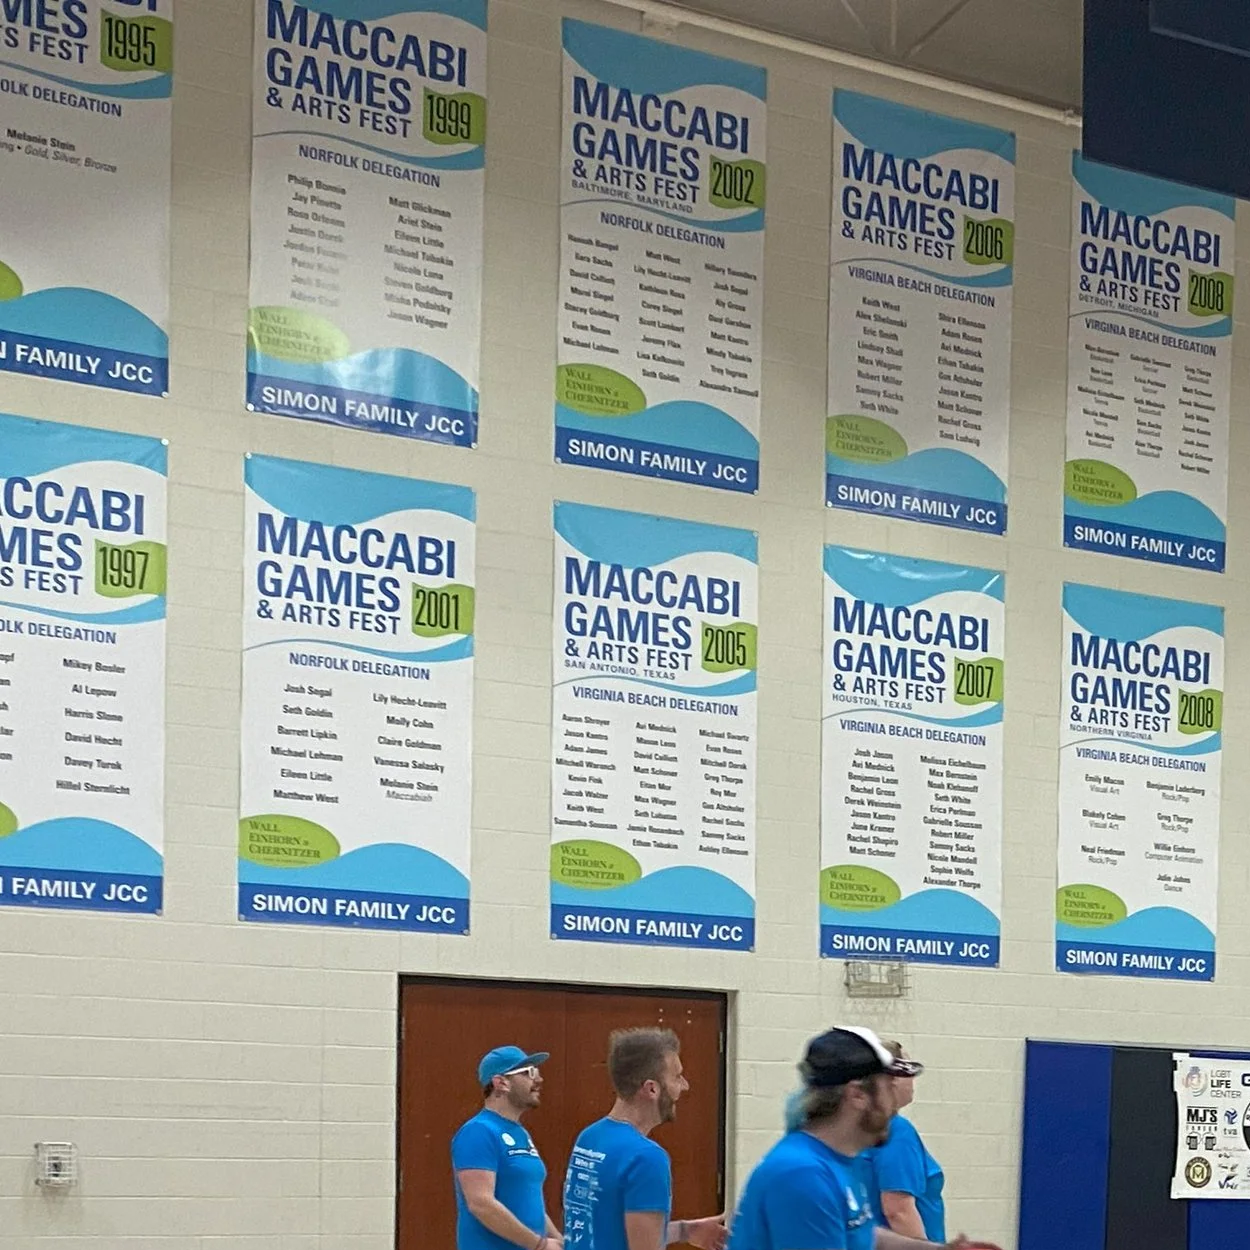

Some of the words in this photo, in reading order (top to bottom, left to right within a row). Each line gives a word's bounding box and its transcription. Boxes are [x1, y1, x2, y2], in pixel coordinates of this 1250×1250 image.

[105, 18, 155, 66] 1995
[267, 0, 467, 87] MACCABI
[267, 47, 411, 115] GAMES
[267, 88, 283, 109] &
[292, 94, 350, 124] ARTS
[360, 109, 411, 138] FEST
[427, 94, 470, 139] 1999
[573, 76, 748, 154] MACCABI
[299, 145, 358, 169] NORFOLK
[362, 159, 440, 188] DELEGATION
[573, 122, 700, 182] GAMES
[573, 159, 587, 179] &
[595, 165, 646, 192] ARTS
[654, 178, 700, 204] FEST
[713, 162, 754, 204] 2002
[843, 143, 998, 213] MACCABI
[637, 195, 693, 213] MARYLAND
[842, 186, 955, 240] GAMES
[601, 212, 653, 234] NORFOLK
[656, 224, 725, 248] DELEGATION
[842, 221, 855, 239] &
[862, 225, 907, 251] ARTS
[915, 237, 955, 261] FEST
[966, 221, 1003, 260] 2006
[1081, 202, 1220, 267] MACCABI
[848, 265, 894, 287] VIRGINIA
[897, 277, 931, 294] BEACH
[935, 285, 995, 307] DELEGATION
[1080, 242, 1181, 293] GAMES
[1080, 275, 1091, 292] &
[1097, 279, 1138, 303] ARTS
[1144, 290, 1180, 312] FEST
[1191, 274, 1223, 311] 2008
[16, 344, 101, 374] FAMILY
[109, 361, 153, 383] JCC
[262, 387, 337, 414] SIMON
[345, 400, 419, 428] FAMILY
[425, 415, 464, 436] JCC
[569, 439, 634, 464] SIMON
[641, 450, 707, 476] FAMILY
[713, 464, 747, 483] JCC
[838, 485, 896, 509] SIMON
[902, 496, 961, 519] FAMILY
[966, 506, 996, 526] JCC
[258, 512, 455, 578] MACCABI
[25, 570, 83, 595] FEST
[99, 546, 149, 590] 1997
[257, 560, 400, 612] GAMES
[565, 557, 740, 617] MACCABI
[257, 600, 273, 619] &
[282, 603, 340, 627] ARTS
[350, 613, 400, 635] FEST
[415, 590, 459, 630] 2001
[565, 602, 691, 650] GAMES
[834, 596, 989, 652] MACCABI
[28, 623, 117, 644] DELEGATION
[705, 628, 746, 665] 2005
[289, 652, 349, 671] NORFOLK
[353, 661, 430, 680] DELEGATION
[564, 660, 585, 669] SAN
[644, 670, 675, 680] TEXAS
[565, 639, 579, 657] &
[587, 642, 639, 664] ARTS
[647, 649, 692, 671] FEST
[833, 639, 946, 683] GAMES
[1072, 632, 1210, 684] MACCABI
[833, 674, 846, 691] &
[853, 676, 898, 698] ARTS
[906, 683, 946, 703] FEST
[957, 663, 993, 698] 2007
[1071, 672, 1171, 714] GAMES
[573, 686, 625, 702] VIRGINIA
[628, 693, 666, 707] BEACH
[670, 698, 738, 716] DELEGATION
[884, 700, 912, 710] TEXAS
[1181, 694, 1213, 728] 2008
[840, 719, 886, 734] VIRGINIA
[889, 725, 923, 739] BEACH
[926, 729, 986, 746] DELEGATION
[1070, 723, 1114, 735] NORTHERN
[1118, 730, 1152, 740] VIRGINIA
[271, 746, 306, 758] Michael
[253, 894, 327, 914] SIMON
[335, 899, 410, 920] FAMILY
[416, 906, 455, 923] JCC
[564, 915, 629, 933] SIMON
[636, 919, 702, 938] FAMILY
[708, 925, 742, 941] JCC
[833, 934, 891, 952] SIMON
[896, 938, 954, 955] FAMILY
[959, 943, 990, 958] JCC
[1211, 1070, 1231, 1078] LGBT
[1211, 1080, 1231, 1088] LIFE
[1211, 1089, 1241, 1098] CENTER
